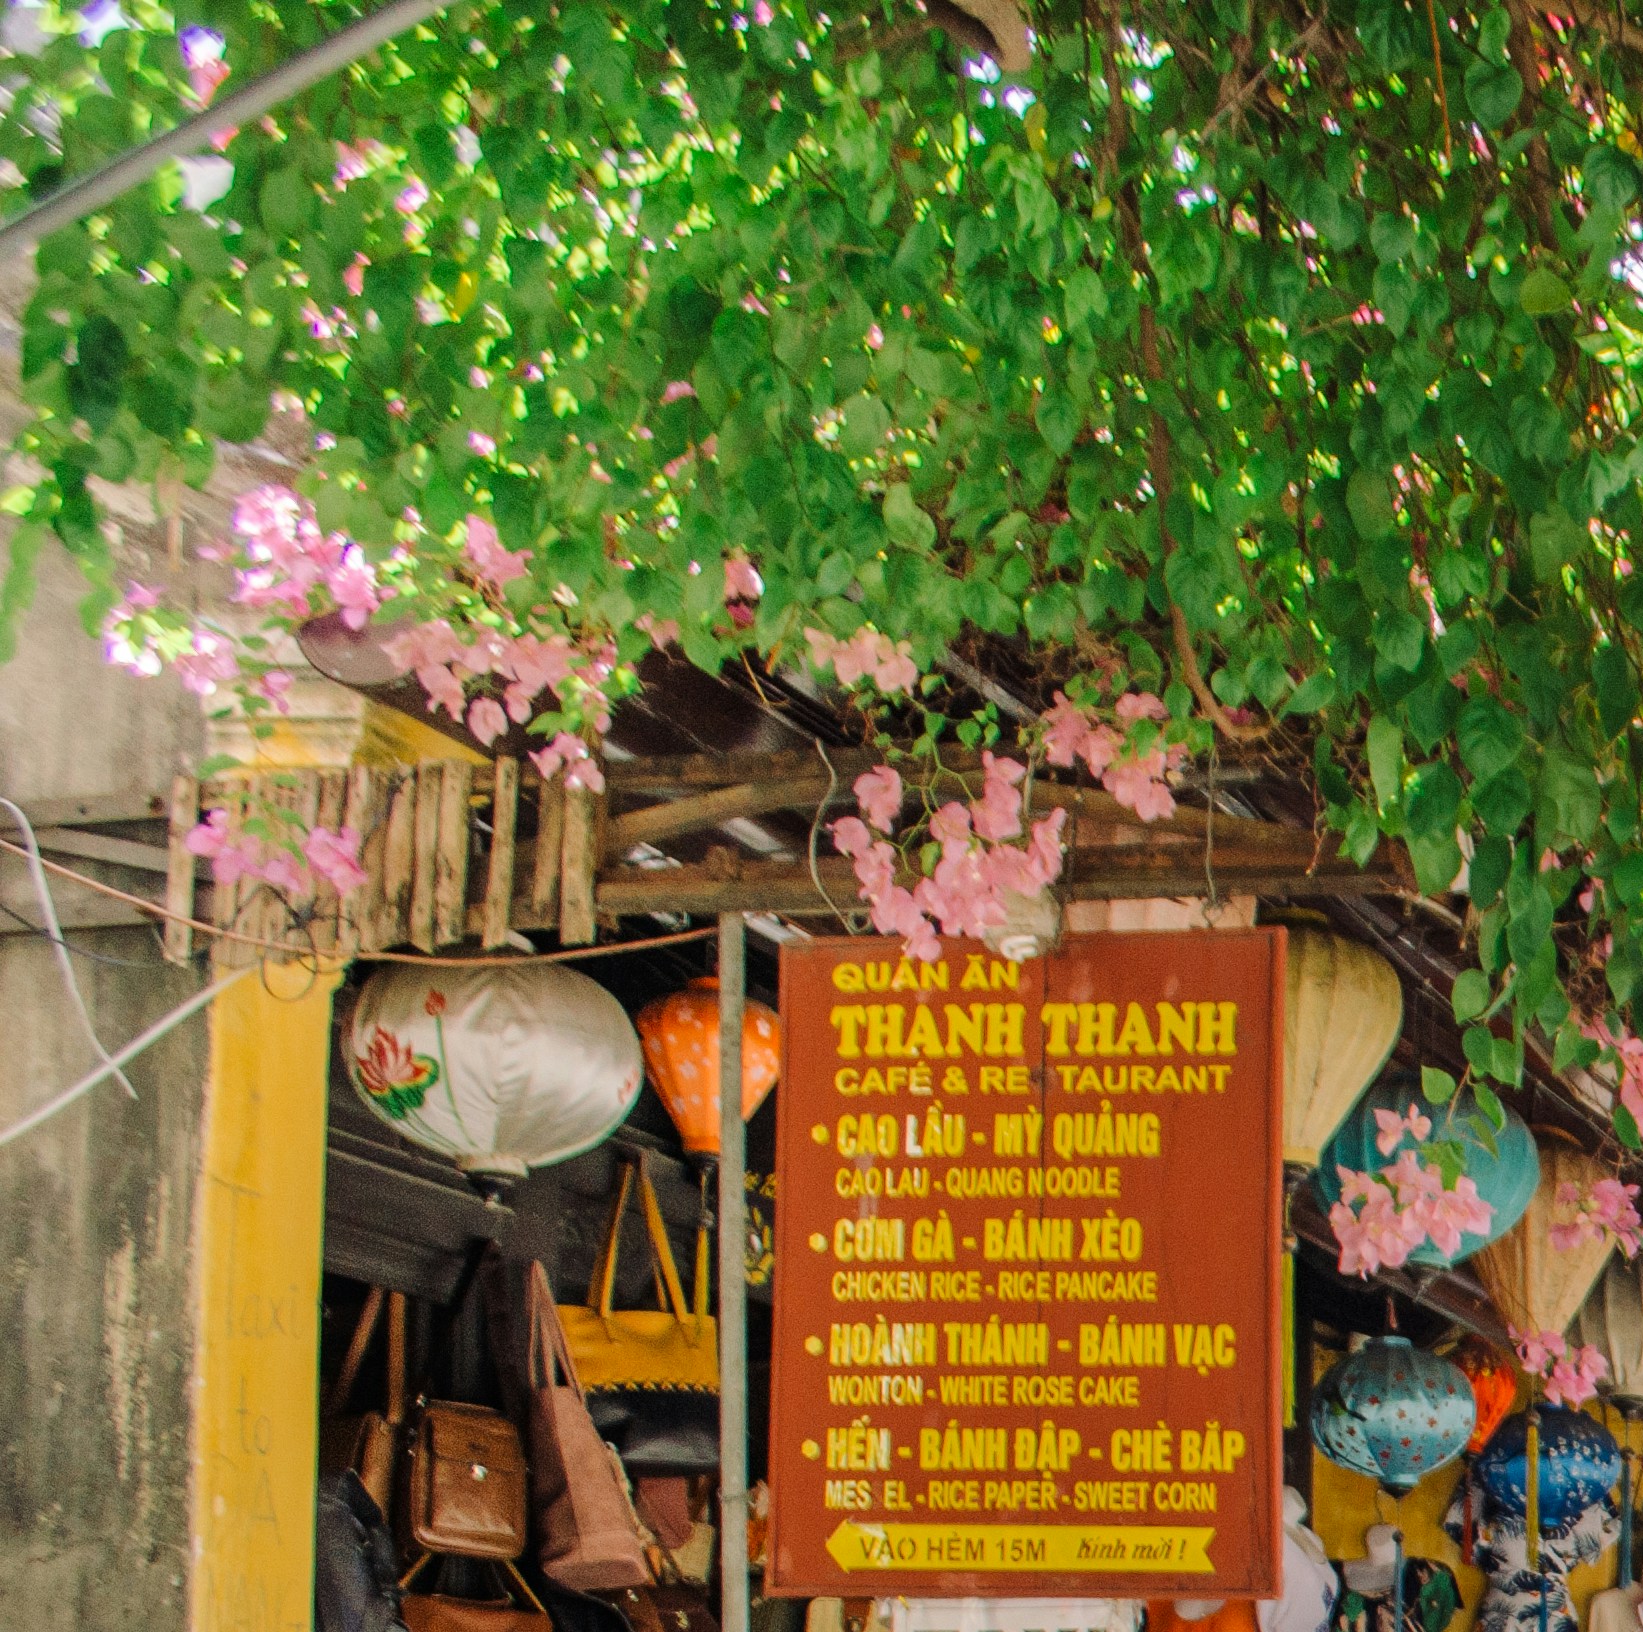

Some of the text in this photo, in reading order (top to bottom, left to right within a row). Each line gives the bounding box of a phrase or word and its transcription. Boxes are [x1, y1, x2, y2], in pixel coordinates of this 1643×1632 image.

[960, 953, 1020, 991] ĂN
[830, 1001, 1238, 1058] THANH THANH
[835, 1060, 933, 1097] CAFÉ
[941, 1066, 968, 1095] &
[837, 1113, 898, 1159] CAO
[994, 1104, 1043, 1157] MỲ
[1053, 1098, 1161, 1160] QUẢNG
[836, 1167, 882, 1198] CAO
[885, 1167, 930, 1198] LAU
[946, 1167, 1024, 1199] QUANG
[1028, 1167, 1120, 1198] NOODLE
[912, 1208, 956, 1262] GÀ
[984, 1208, 1073, 1262] BÁNH
[1080, 1208, 1143, 1262] XÈO
[832, 1271, 927, 1301] CHICKEN
[930, 1271, 981, 1301] RICE
[998, 1271, 1050, 1301] RICE
[1055, 1271, 1157, 1301] PANCAKE
[829, 1313, 937, 1367] HOÀNH
[944, 1313, 1048, 1367] THÁNH
[1079, 1314, 1167, 1368] BÁNH
[1173, 1323, 1237, 1376] VẠC
[828, 1375, 924, 1406] WONTON
[939, 1375, 1008, 1406] WHITE
[1012, 1375, 1075, 1407] ROSE
[1079, 1376, 1140, 1407] CAKE
[919, 1418, 1008, 1472] BÁNH
[1013, 1419, 1081, 1482] ĐẬP
[1111, 1420, 1173, 1473] CHÈ
[928, 1480, 980, 1512] RICE
[984, 1480, 1057, 1512] PAPER
[1073, 1481, 1149, 1512] SWEET
[1153, 1482, 1217, 1513] CORN
[997, 1538, 1046, 1562] 15M
